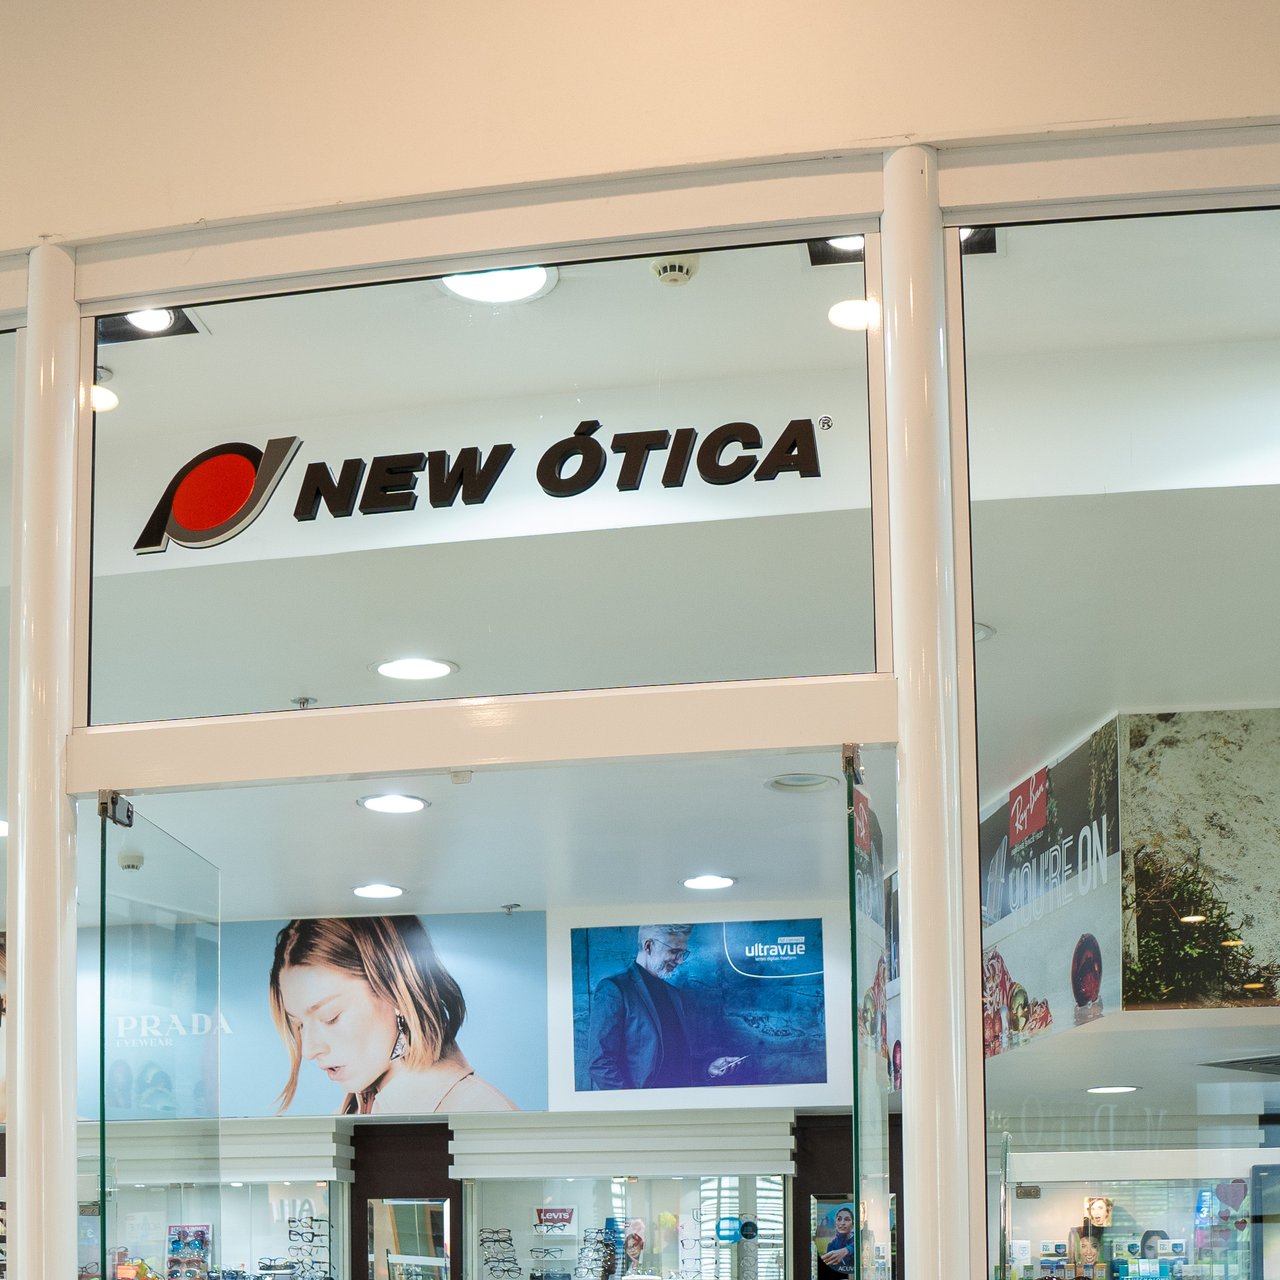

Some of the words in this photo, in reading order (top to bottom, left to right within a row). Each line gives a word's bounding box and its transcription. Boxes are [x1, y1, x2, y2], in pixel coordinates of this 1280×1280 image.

[293, 443, 516, 521] NEW
[536, 418, 822, 498] ÓTICA
[1078, 813, 1108, 896] ON
[745, 943, 806, 957] ultravue
[116, 1011, 234, 1038] PRADA
